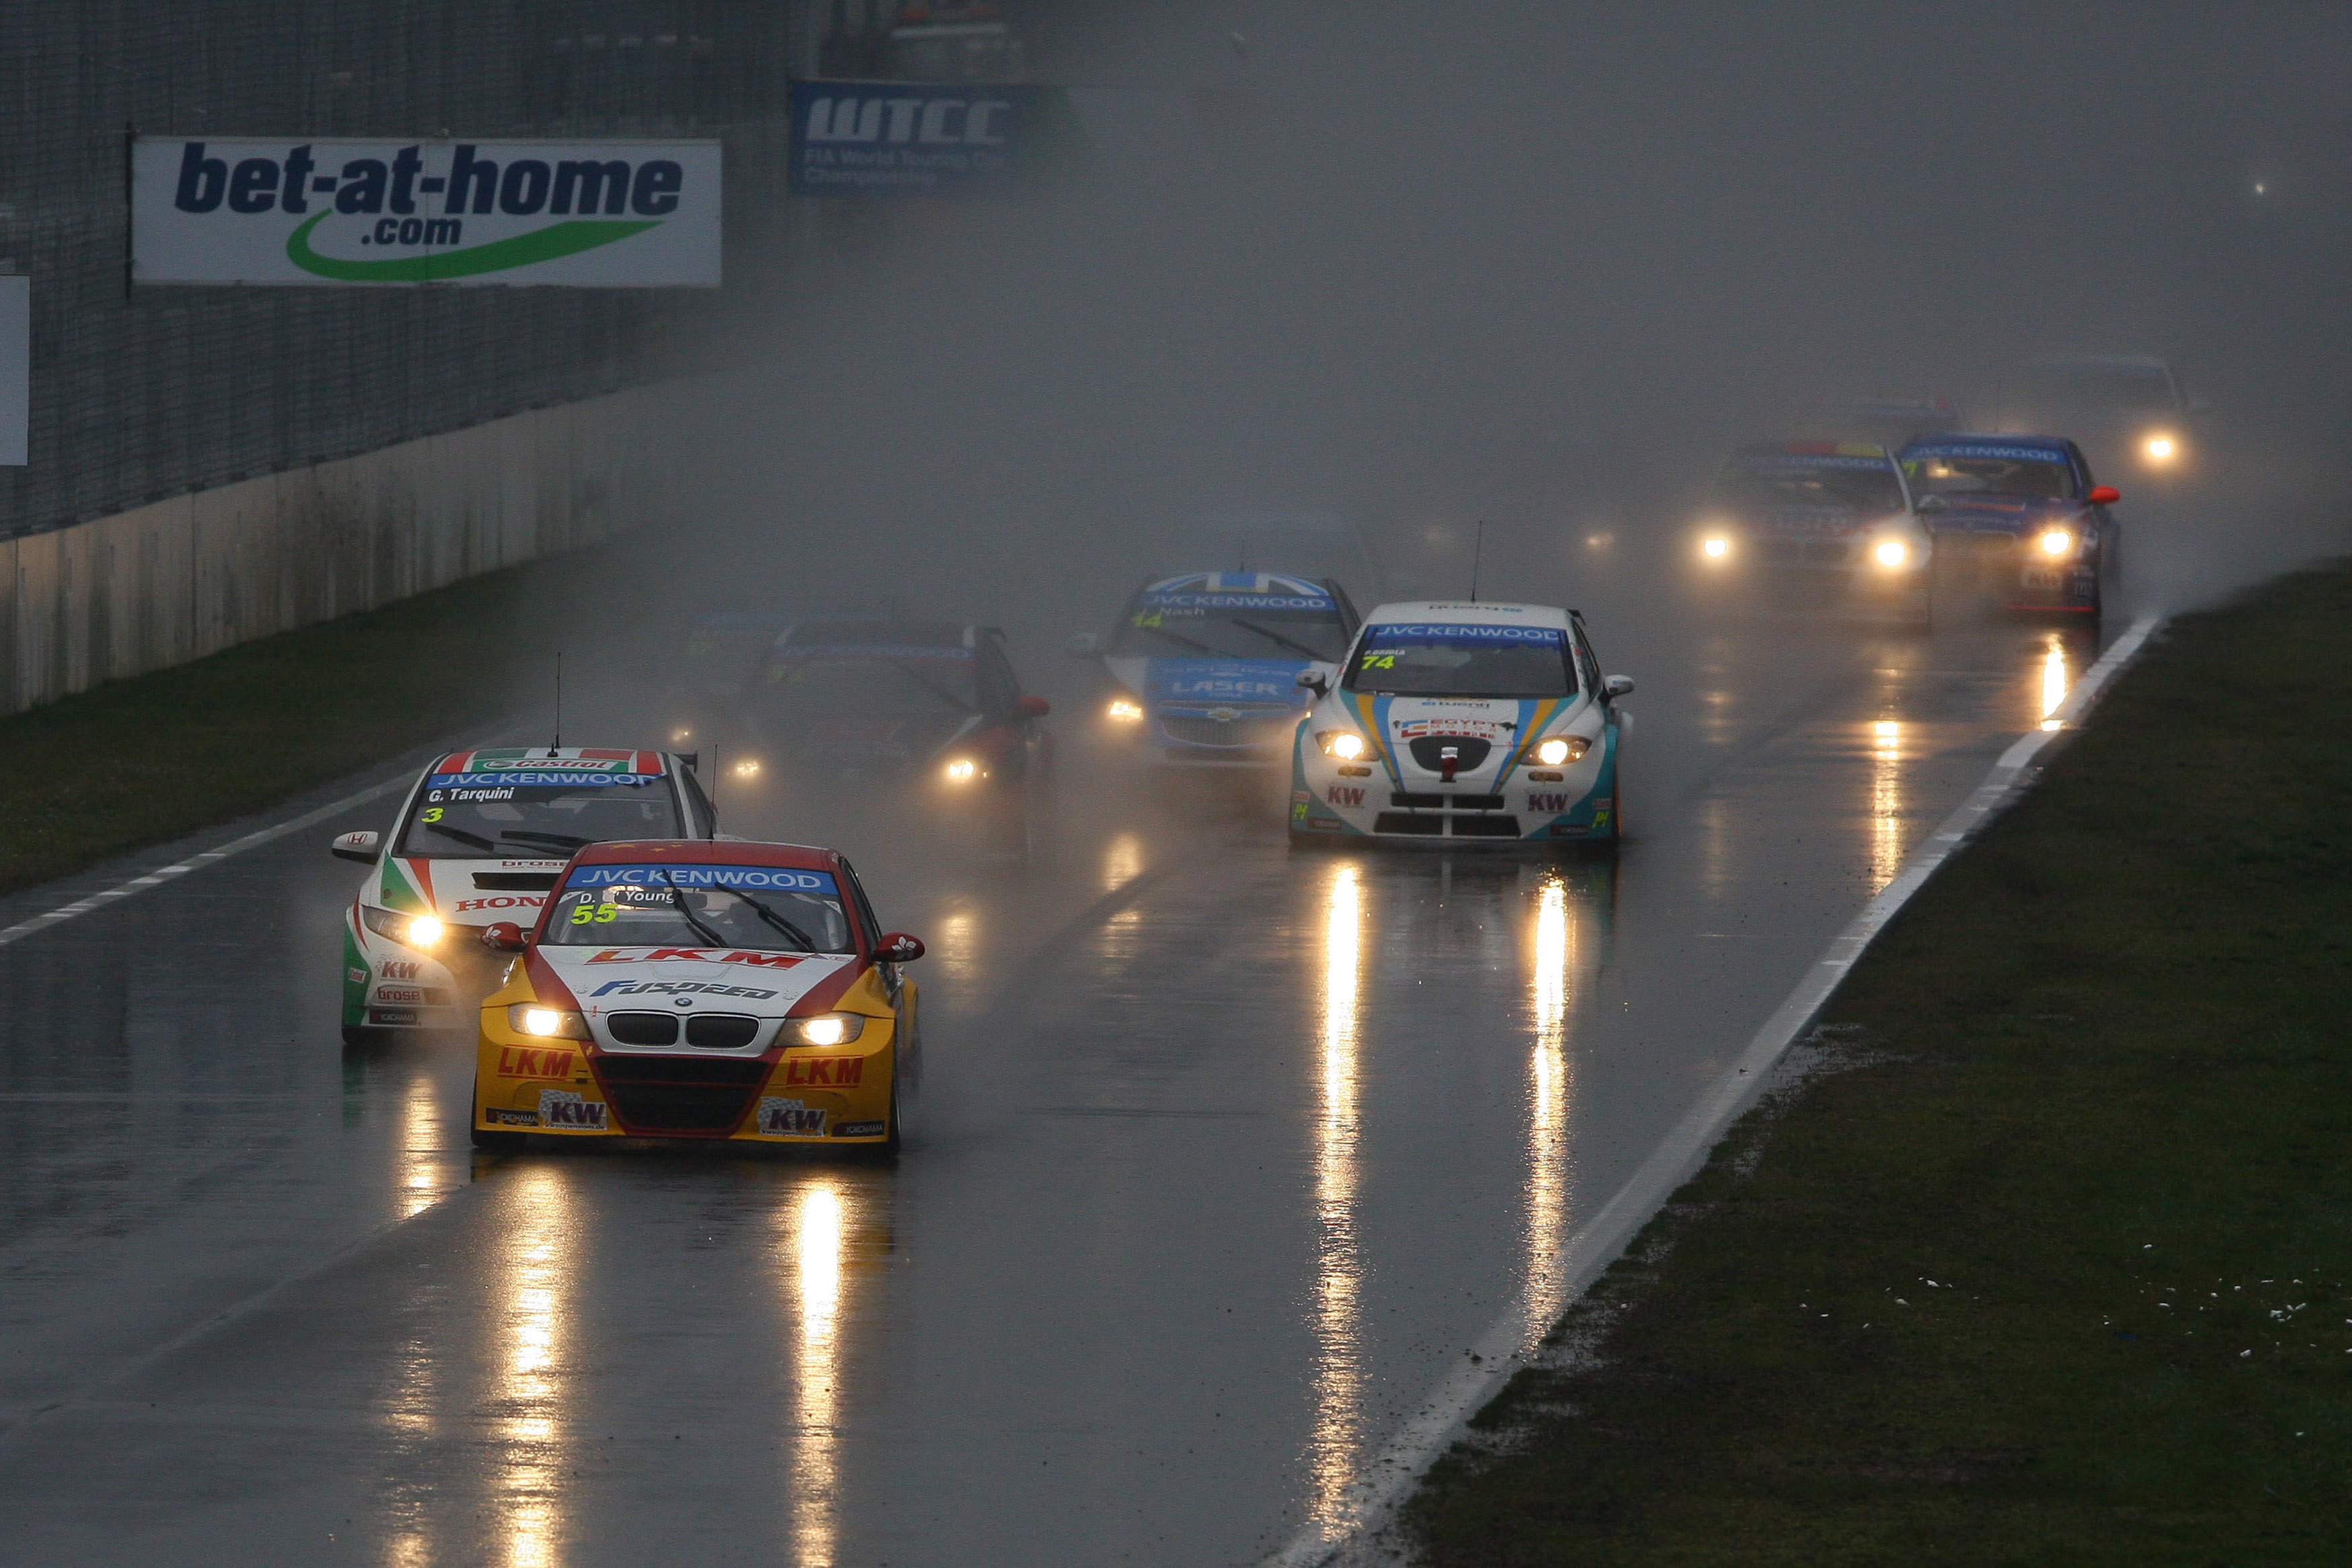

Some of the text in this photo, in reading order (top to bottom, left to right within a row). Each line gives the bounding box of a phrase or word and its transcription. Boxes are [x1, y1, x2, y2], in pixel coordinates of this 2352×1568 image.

[806, 97, 1009, 145] WTCC
[175, 142, 683, 215] bet-at-home
[362, 218, 462, 246] .com
[1361, 655, 1394, 670] 74
[1172, 681, 1278, 695] LASER
[515, 760, 606, 770] Castrol
[429, 787, 514, 803] G. Tarquini
[1328, 786, 1365, 805] KW
[1528, 794, 1567, 812] KW
[422, 807, 444, 823] 3
[456, 897, 547, 912] HON
[580, 893, 595, 903] D.
[571, 904, 618, 925] 55
[587, 948, 805, 969] LKM
[381, 961, 423, 979] KW
[377, 987, 420, 1000] brose
[498, 1049, 575, 1077] LKM
[787, 1058, 864, 1085] LKM
[551, 1102, 604, 1124] KW
[769, 1110, 826, 1130] KW
